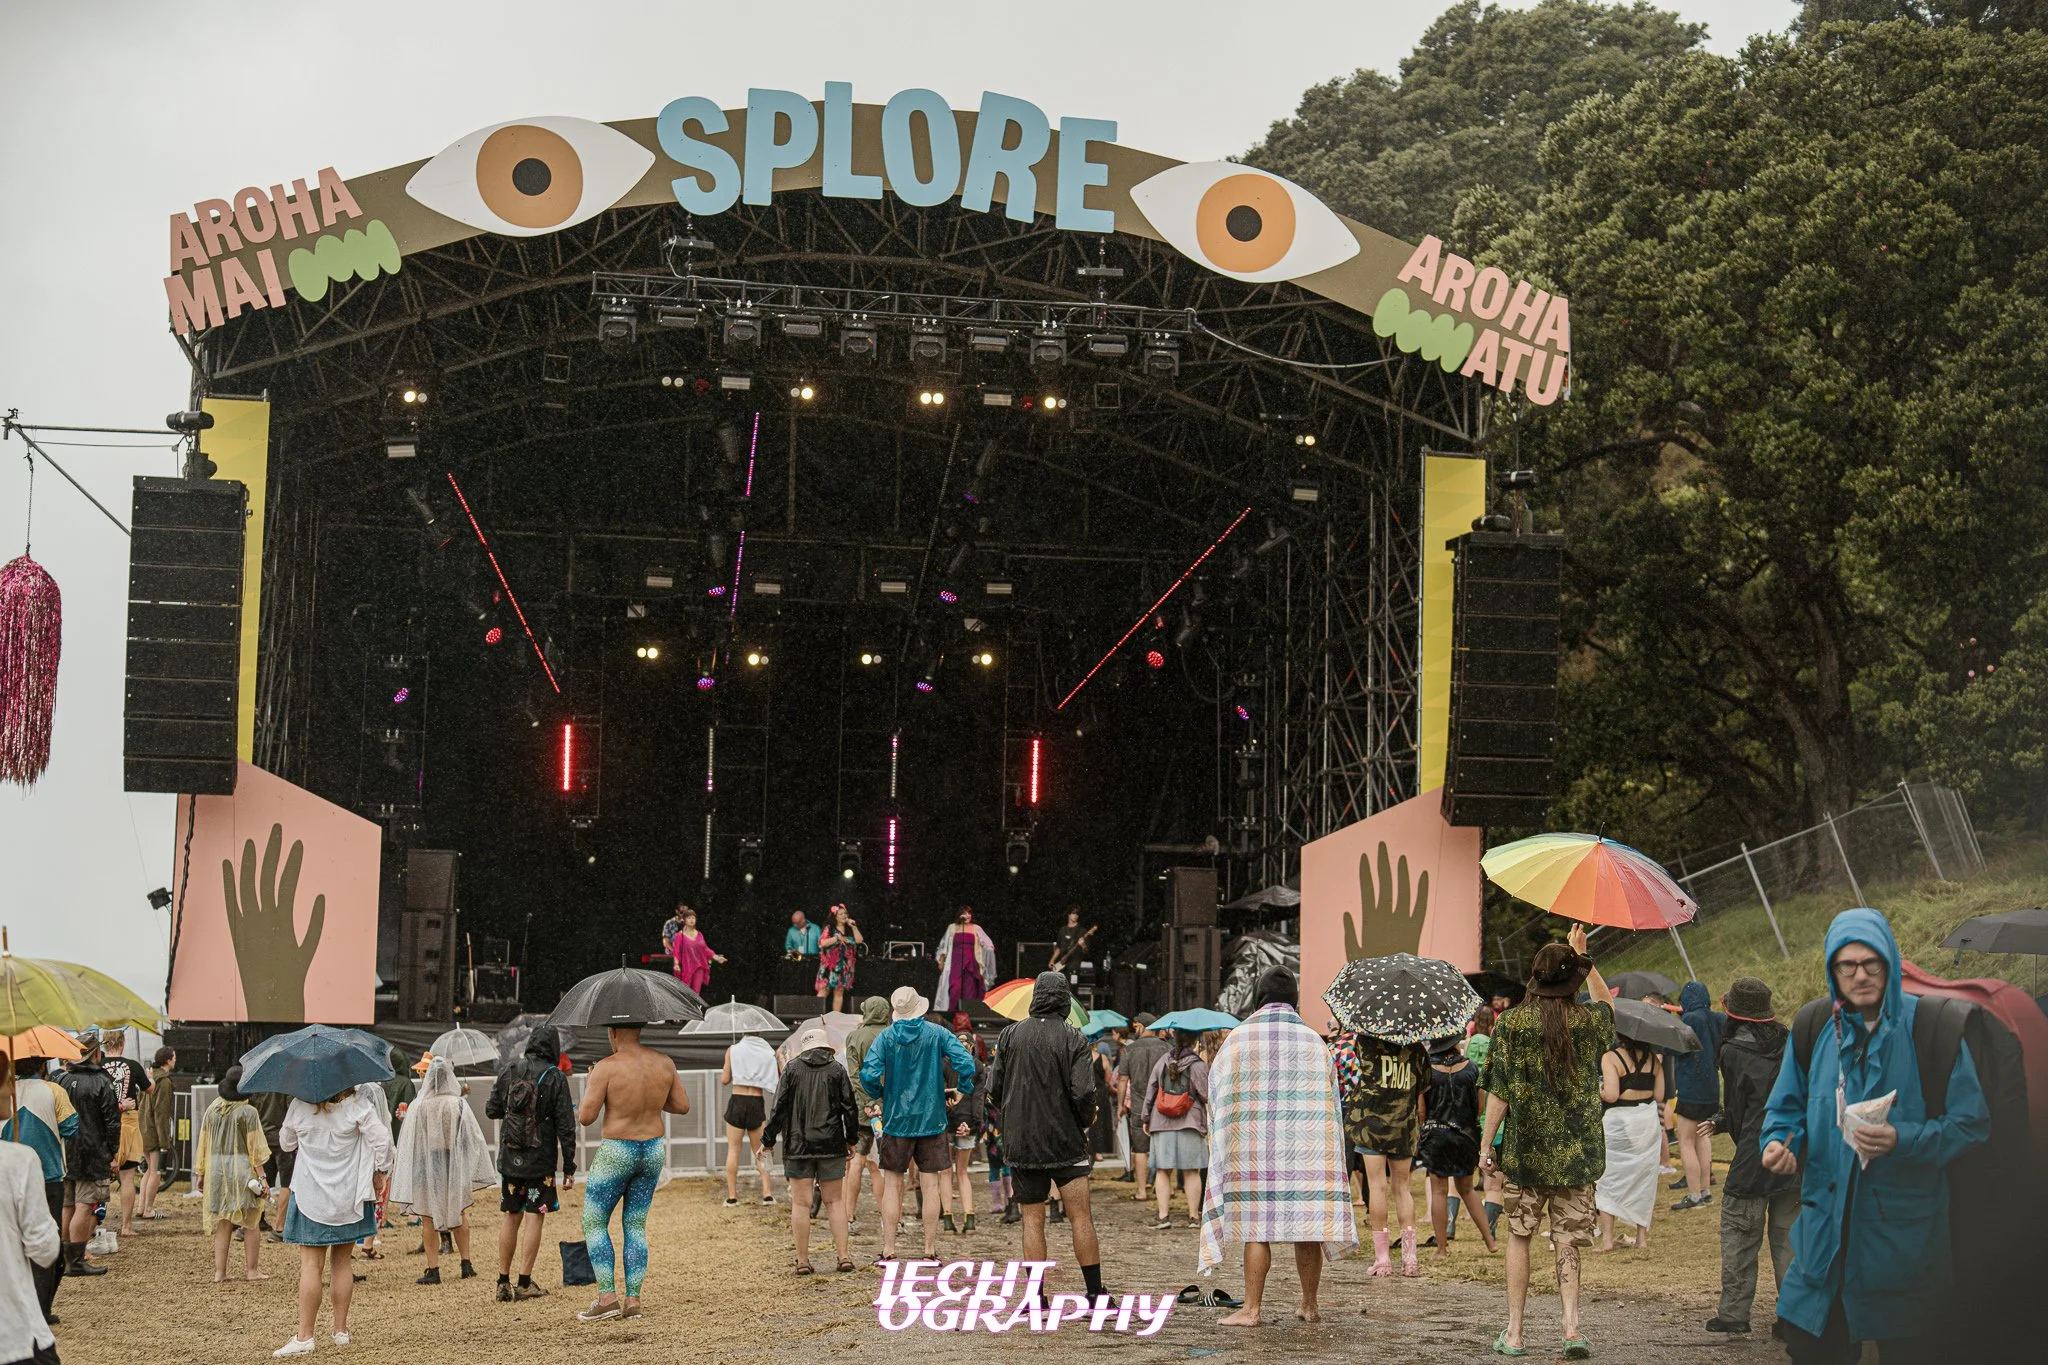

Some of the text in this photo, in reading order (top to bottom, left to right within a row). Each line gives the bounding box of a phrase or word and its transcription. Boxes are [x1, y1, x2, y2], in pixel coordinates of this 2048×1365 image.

[656, 80, 1118, 234] SPLORE
[170, 166, 364, 272] AROHA
[163, 248, 287, 336] MAI
[1396, 234, 1570, 352] AROHA
[1460, 328, 1567, 406] ATU
